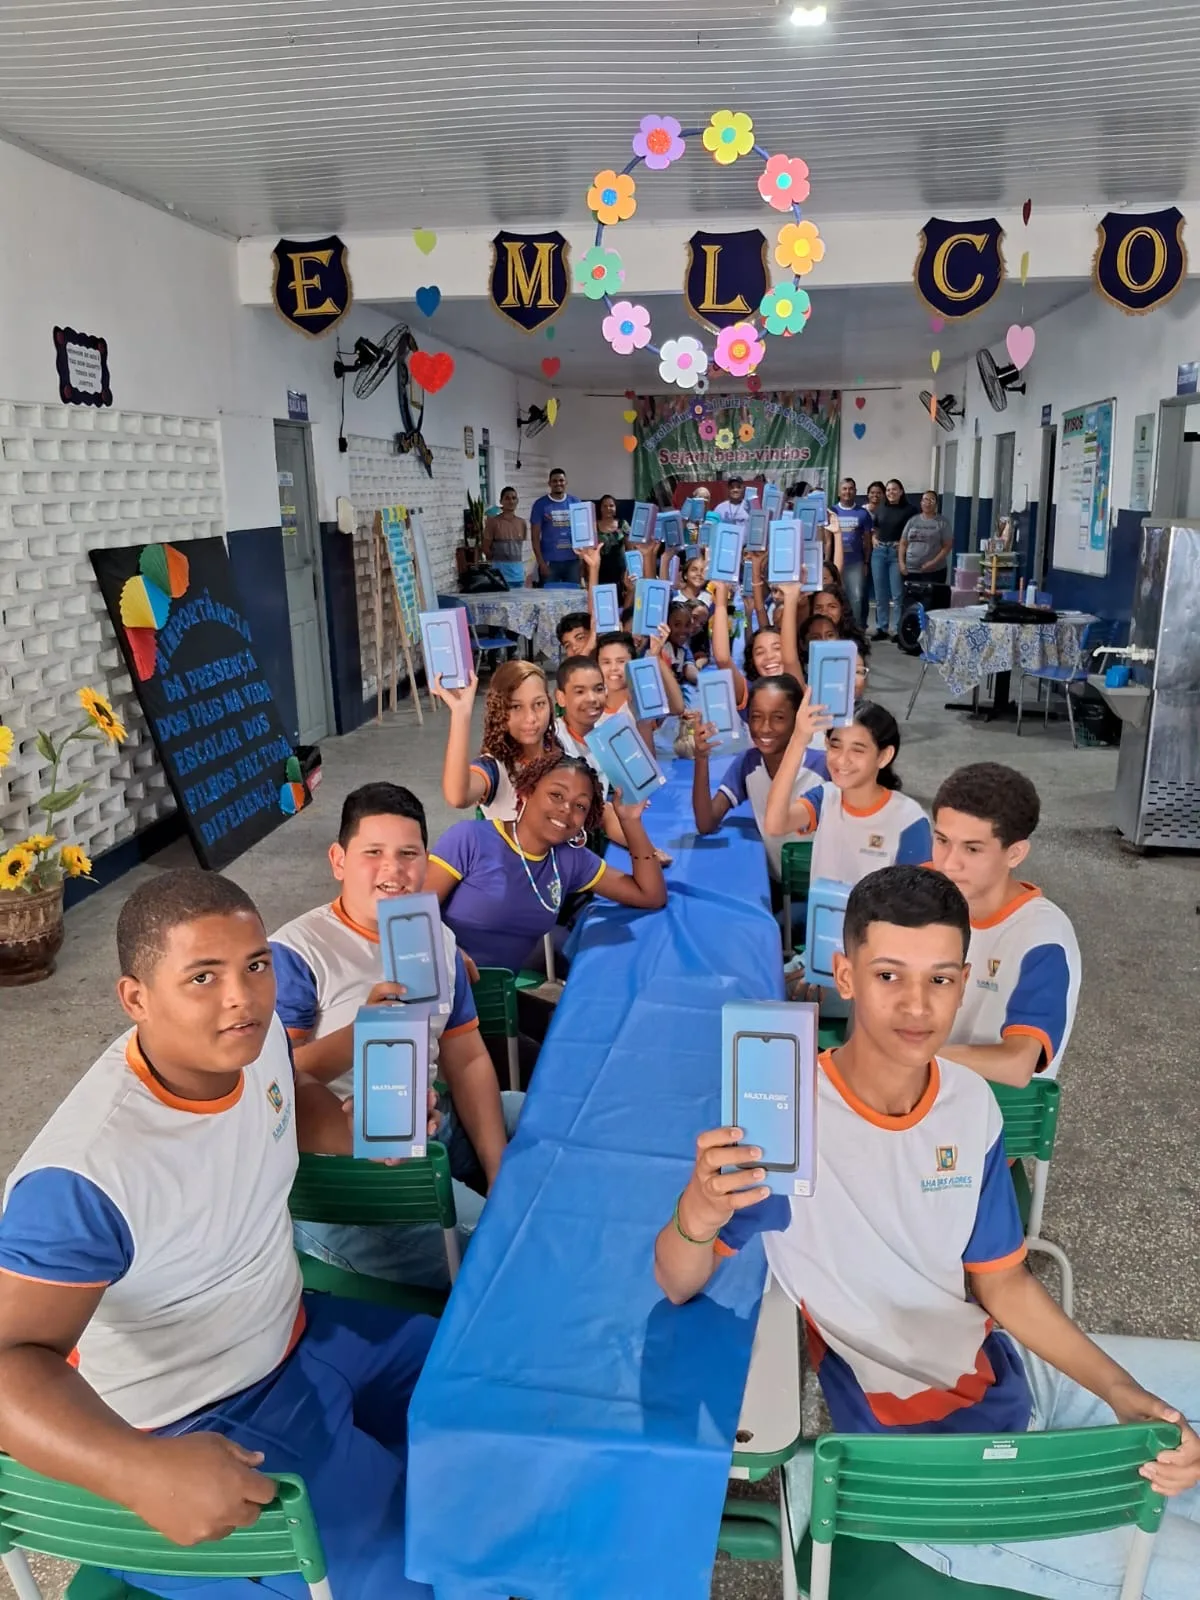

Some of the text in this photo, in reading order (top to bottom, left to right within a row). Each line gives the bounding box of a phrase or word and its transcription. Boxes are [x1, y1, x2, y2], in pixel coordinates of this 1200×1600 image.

[287, 226, 1168, 318] E M L C O
[659, 446, 811, 468] Sejam bem-vindos
[162, 648, 258, 702] DA PRESENÇA
[189, 698, 224, 728] PAIS
[222, 688, 245, 713] NA
[241, 680, 273, 705] VIDA
[172, 712, 271, 777] ESCOLAR DOS
[235, 751, 264, 783] FAZ
[259, 735, 294, 768] TODA
[200, 779, 280, 846] DIFERENÇA
